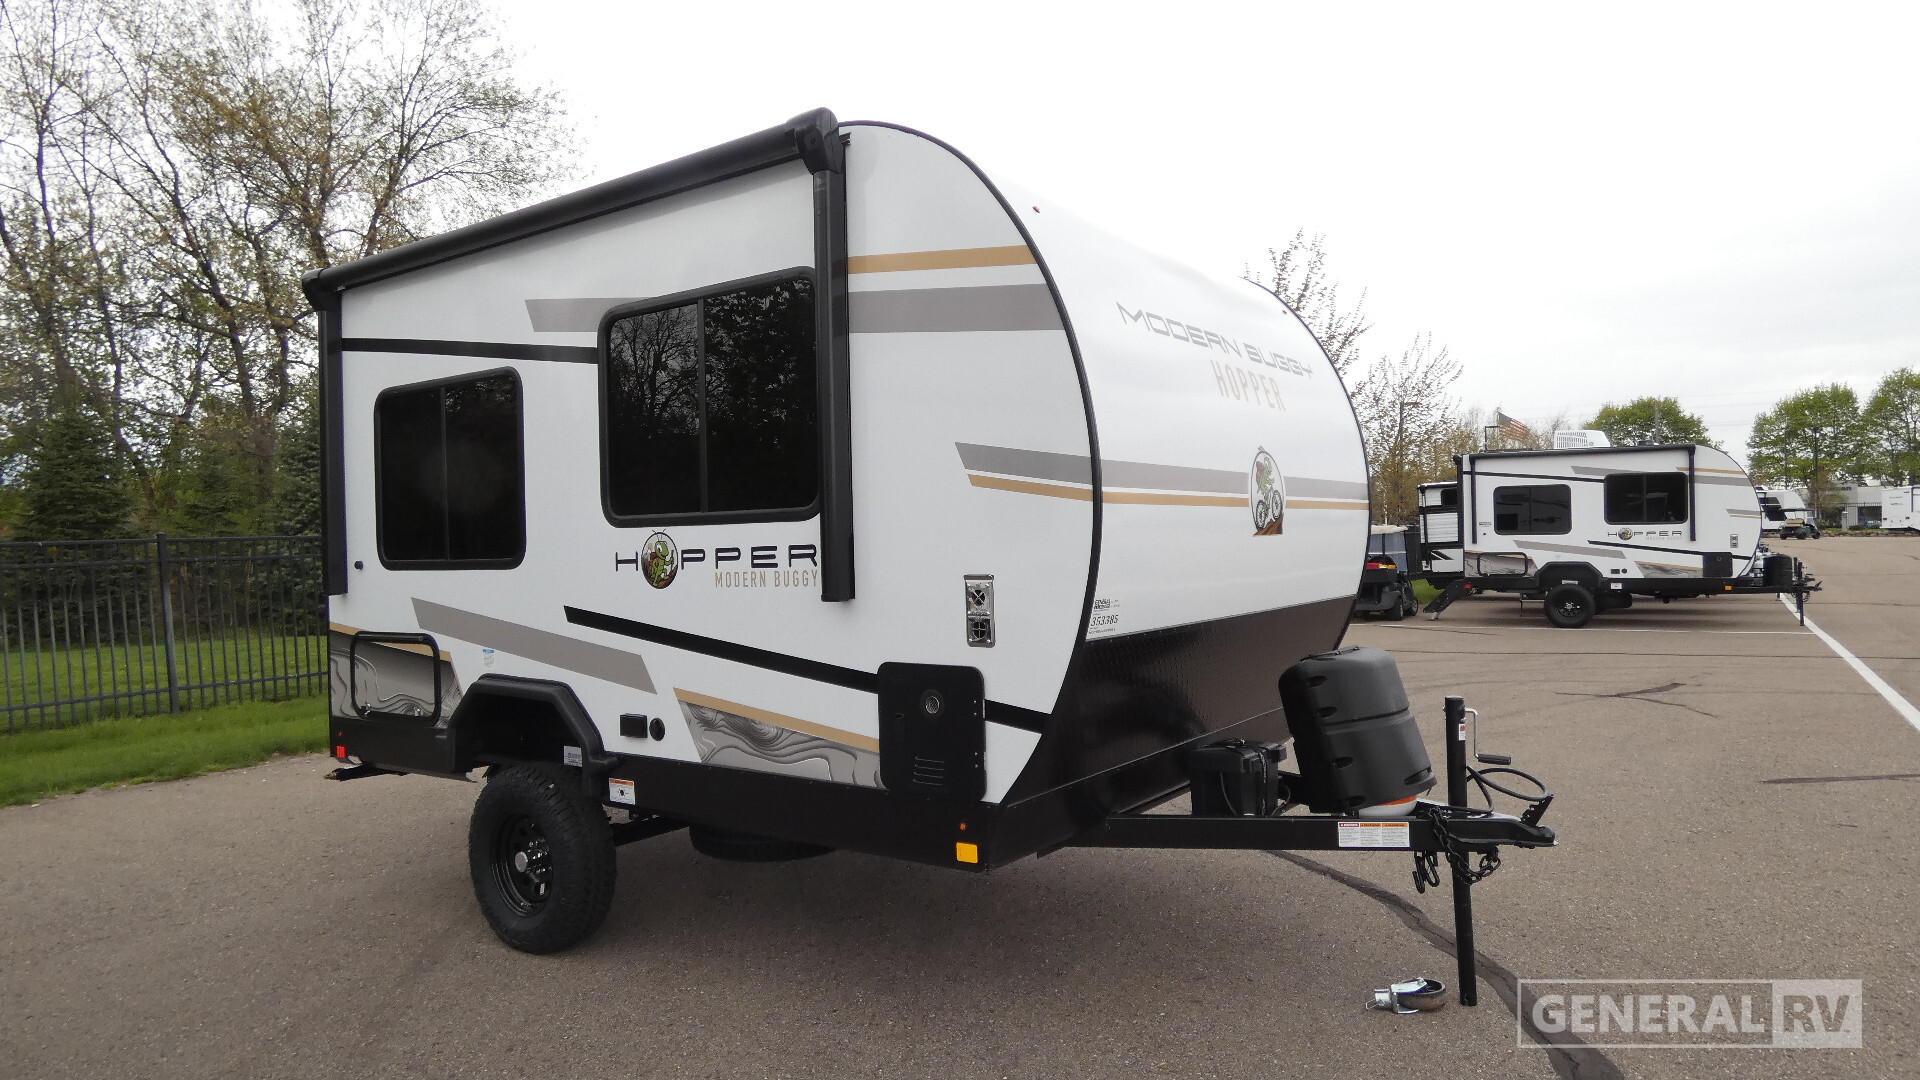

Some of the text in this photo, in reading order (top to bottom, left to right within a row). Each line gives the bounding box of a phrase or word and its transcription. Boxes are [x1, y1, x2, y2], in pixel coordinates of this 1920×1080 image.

[1116, 302, 1313, 379] MODERN BUGGY
[1210, 359, 1287, 411] HOPPER
[715, 570, 818, 588] MODERN BUGGY
